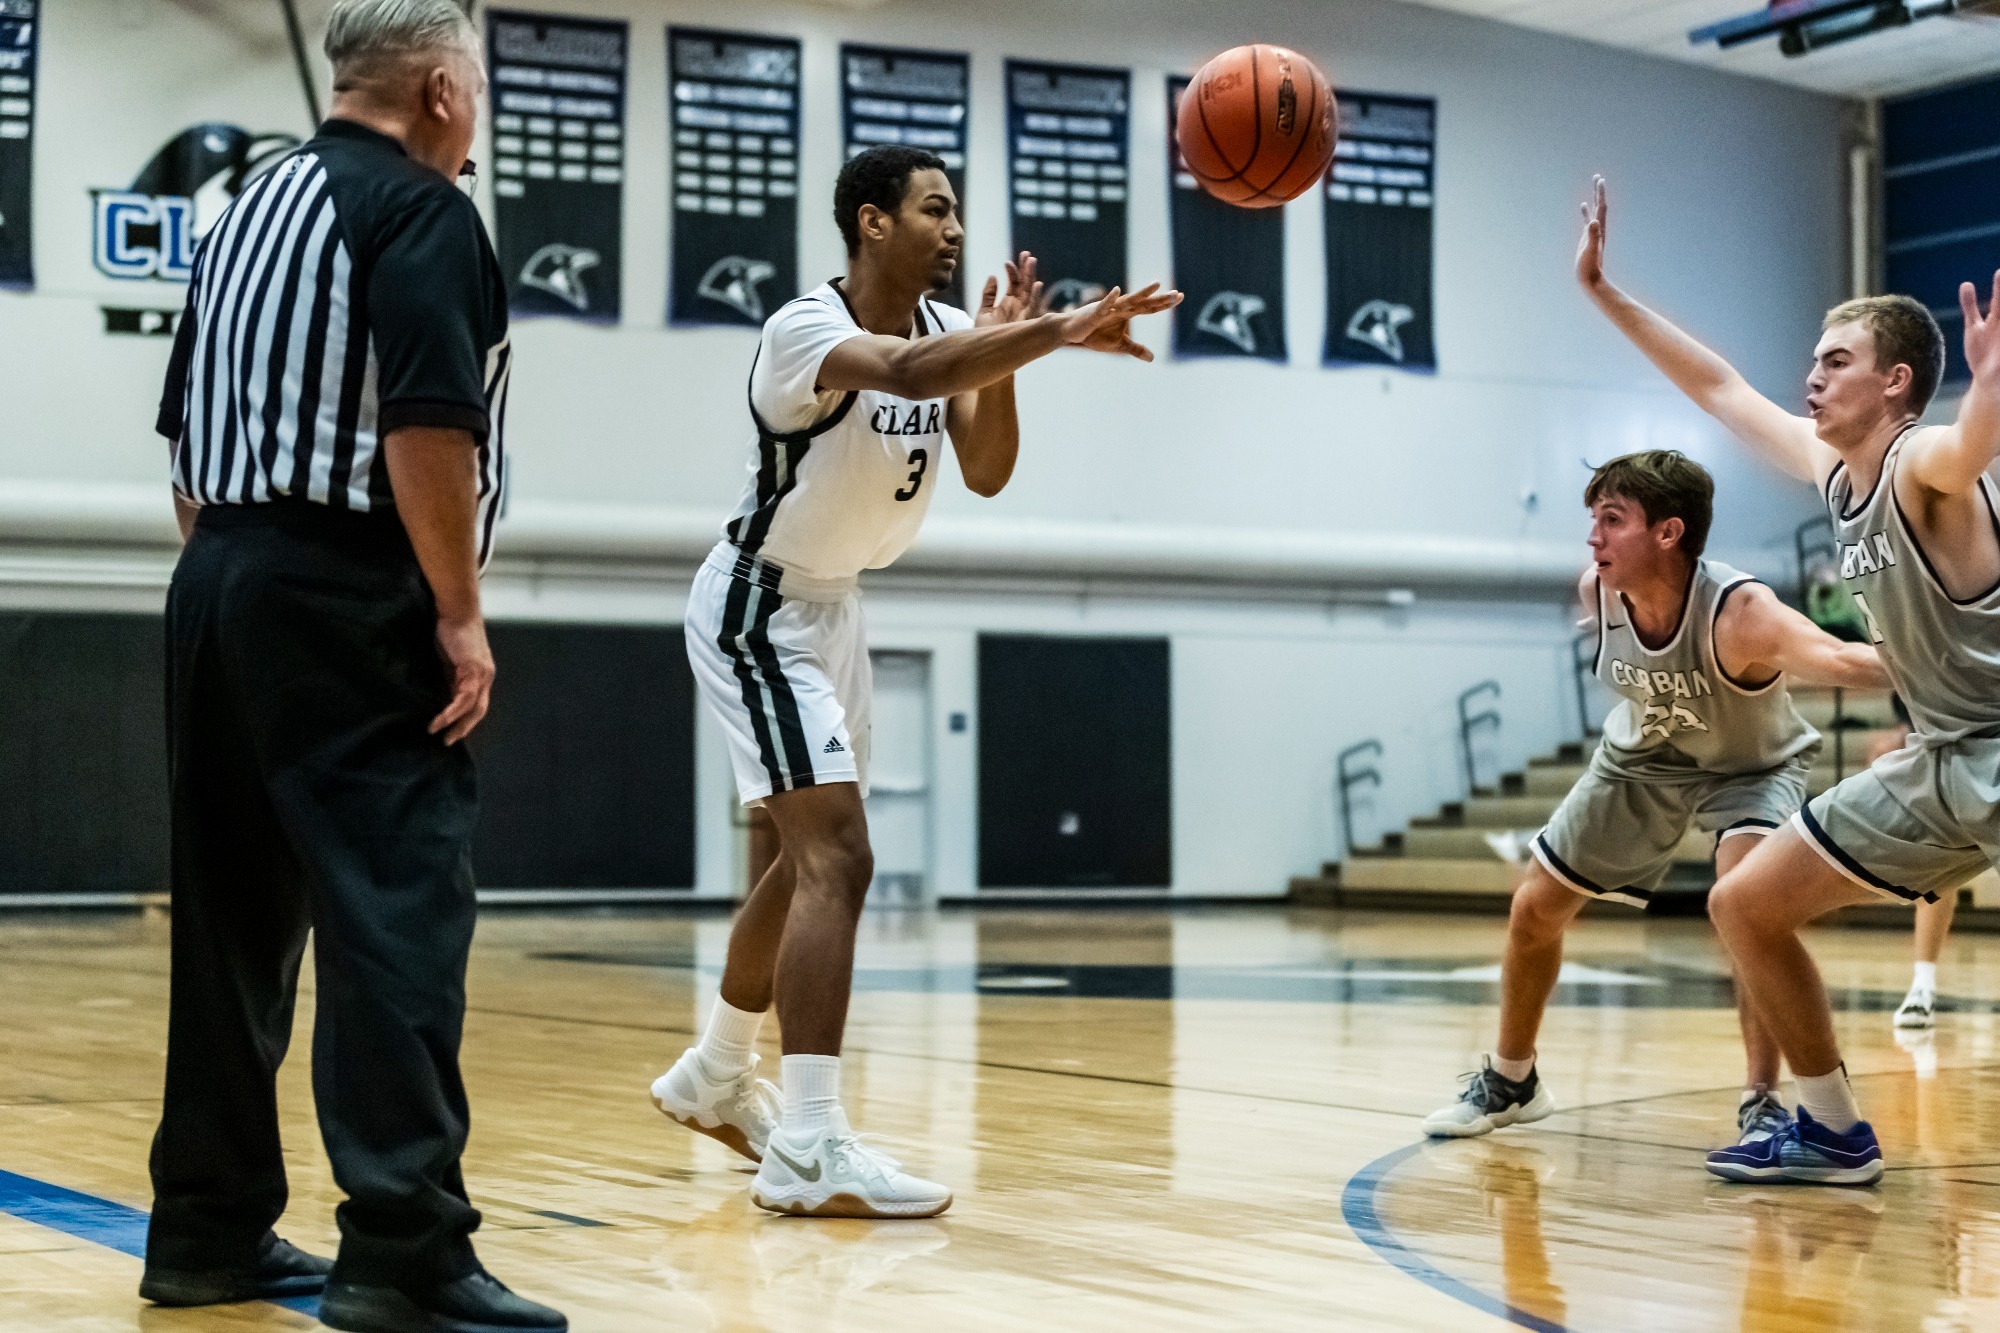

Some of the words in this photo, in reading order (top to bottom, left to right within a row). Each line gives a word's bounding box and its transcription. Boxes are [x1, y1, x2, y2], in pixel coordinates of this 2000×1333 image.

[870, 403, 940, 435] CLAR
[894, 448, 928, 502] 3
[1836, 530, 1897, 580] BAN
[1611, 658, 1713, 699] CORBAN
